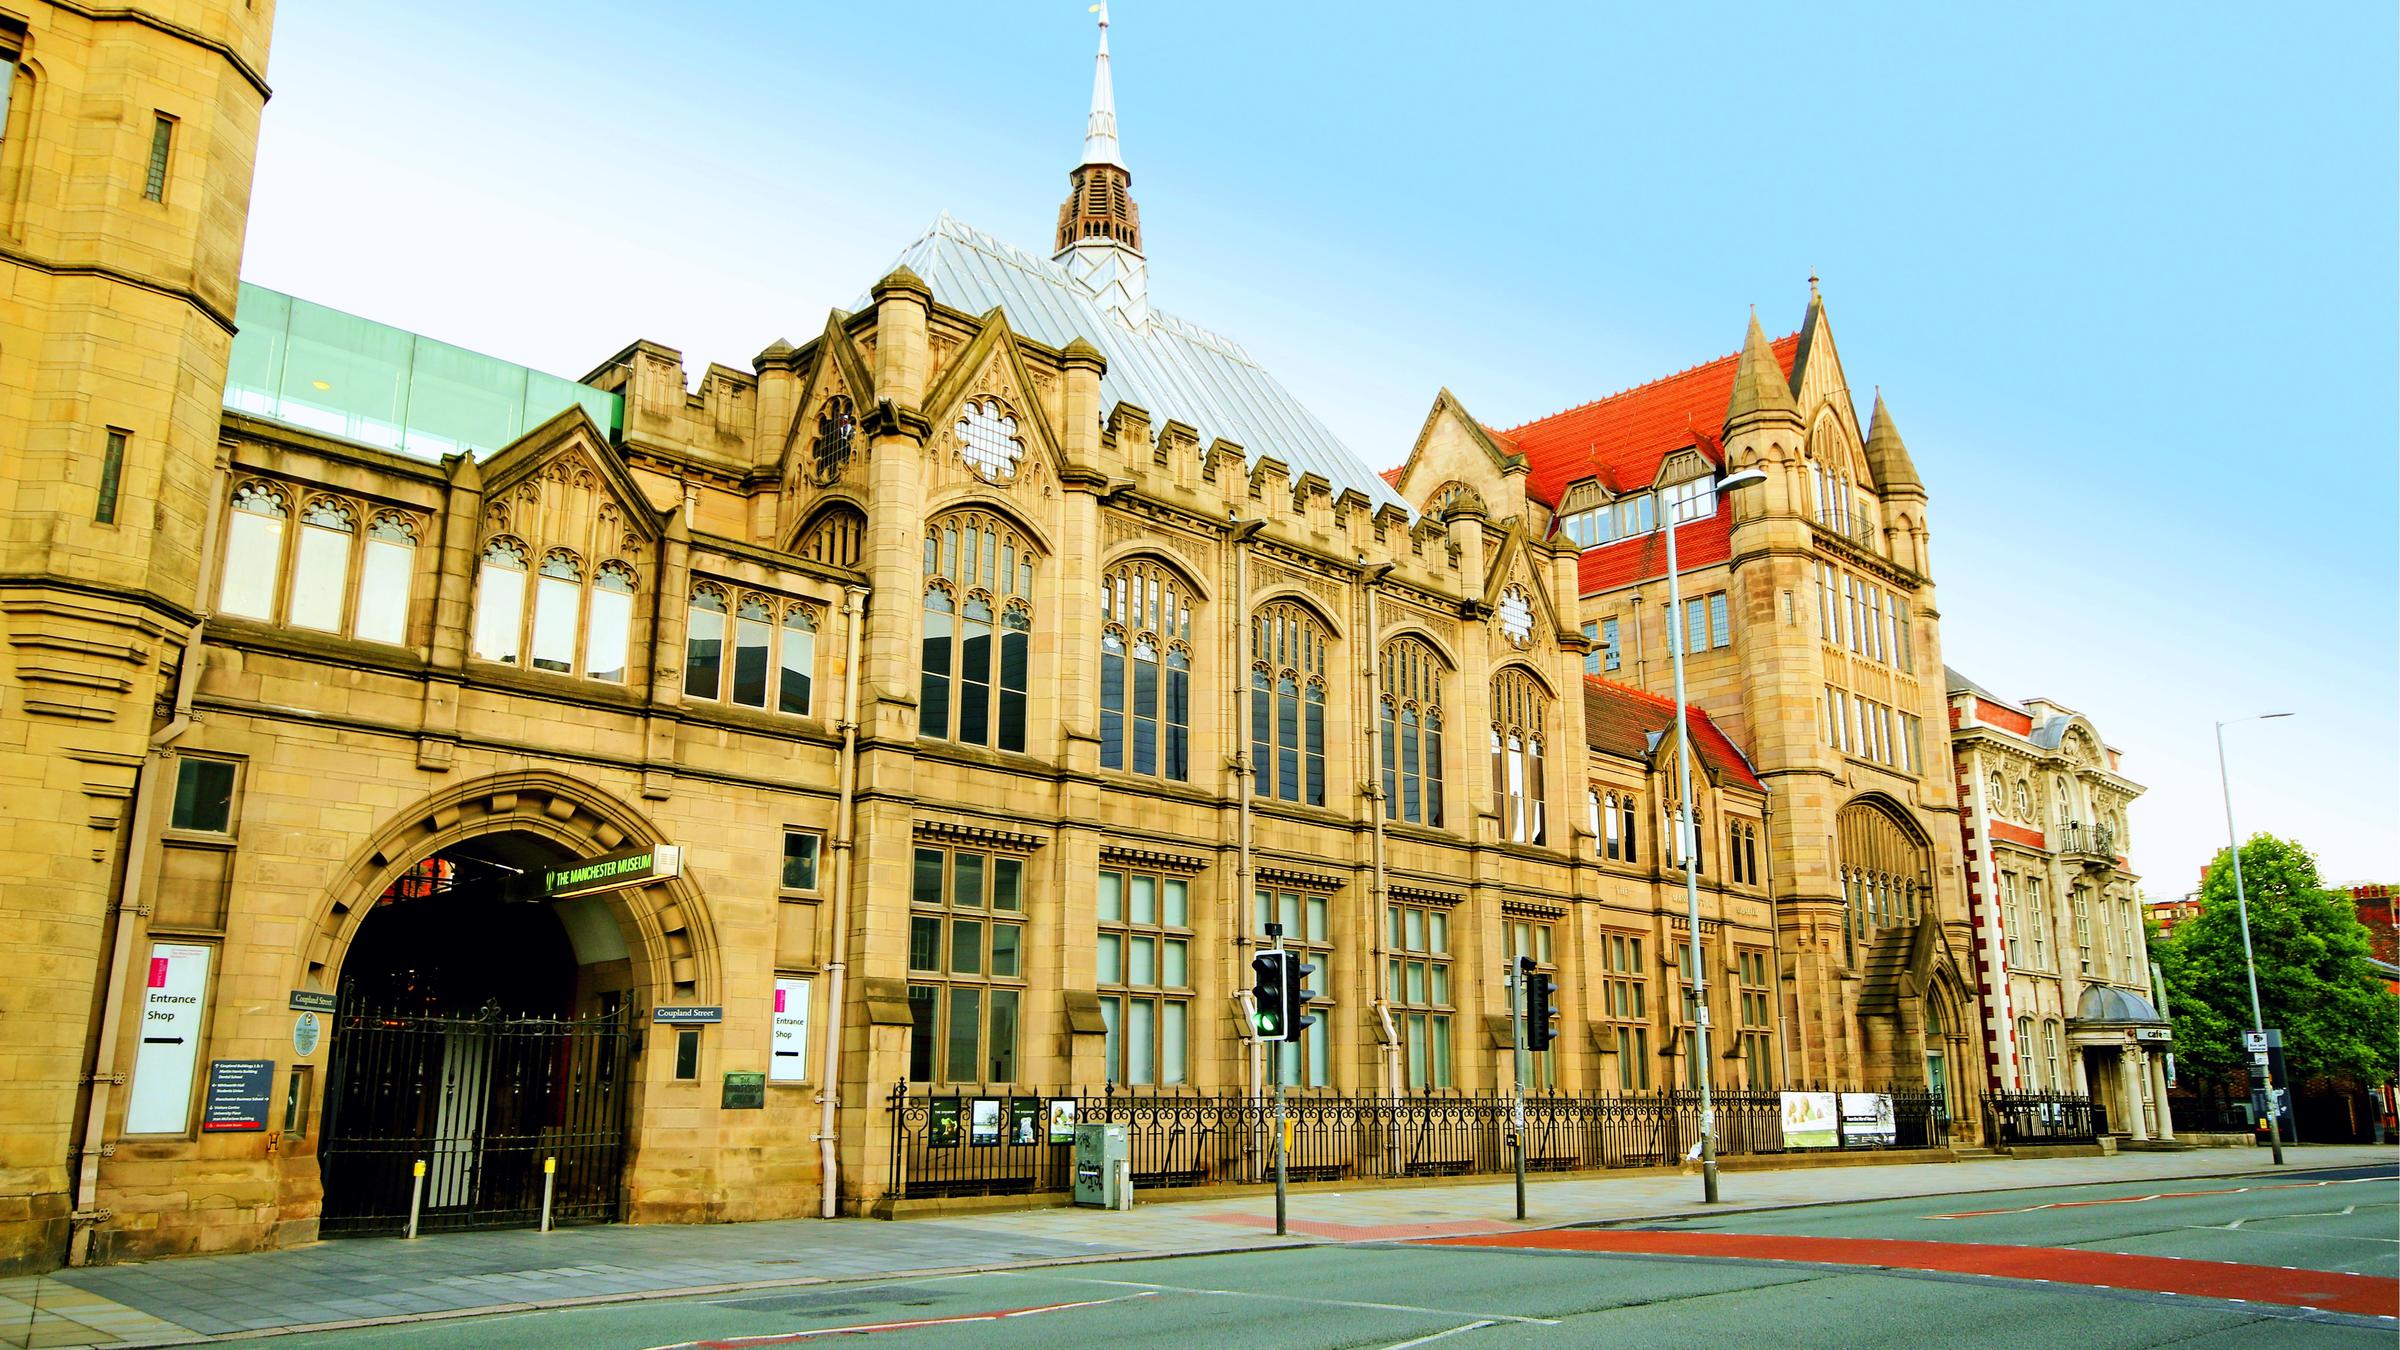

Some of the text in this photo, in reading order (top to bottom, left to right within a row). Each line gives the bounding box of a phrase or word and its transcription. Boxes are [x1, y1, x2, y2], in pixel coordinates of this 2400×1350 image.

[557, 872, 570, 886] THE
[570, 862, 617, 883] MANCHESTER
[617, 854, 652, 874] MUSEUM
[150, 993, 197, 1004] Entrance
[295, 994, 333, 1006] Coupland Street
[147, 1010, 175, 1022] Shop
[657, 1009, 714, 1019] Coupland Street
[776, 1017, 804, 1026] Entrance
[775, 1031, 792, 1039] Shop
